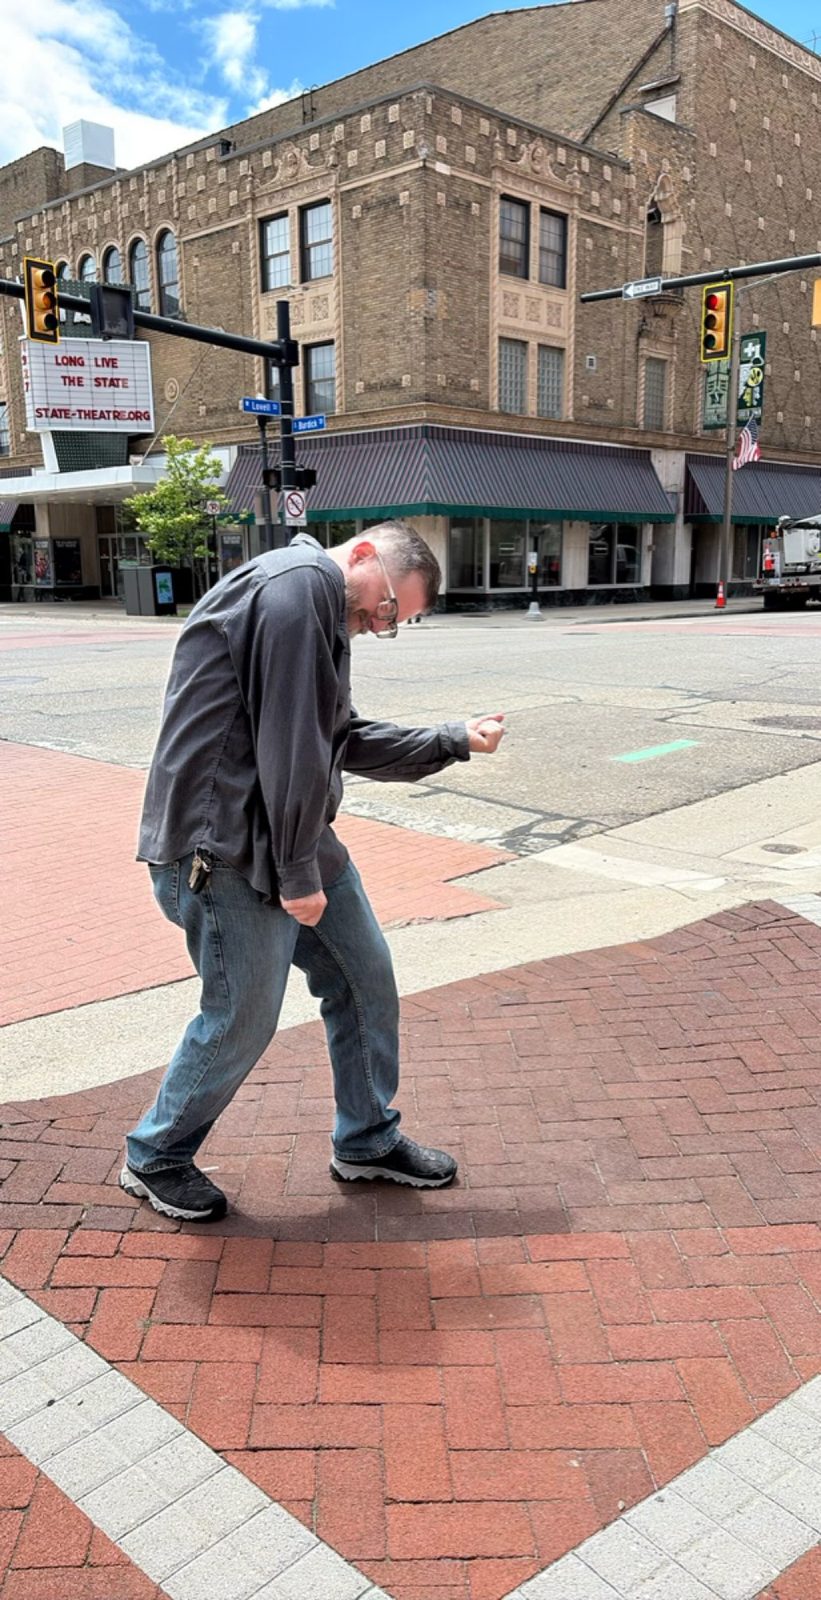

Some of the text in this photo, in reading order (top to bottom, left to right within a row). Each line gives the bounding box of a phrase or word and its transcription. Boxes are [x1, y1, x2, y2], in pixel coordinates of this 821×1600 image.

[54, 354, 119, 369] LONG LIVE
[60, 375, 129, 389] THE STATE
[251, 401, 272, 412] Lovell
[35, 407, 151, 421] STATE-THEATRE.ORG
[298, 419, 318, 430] Burdick
